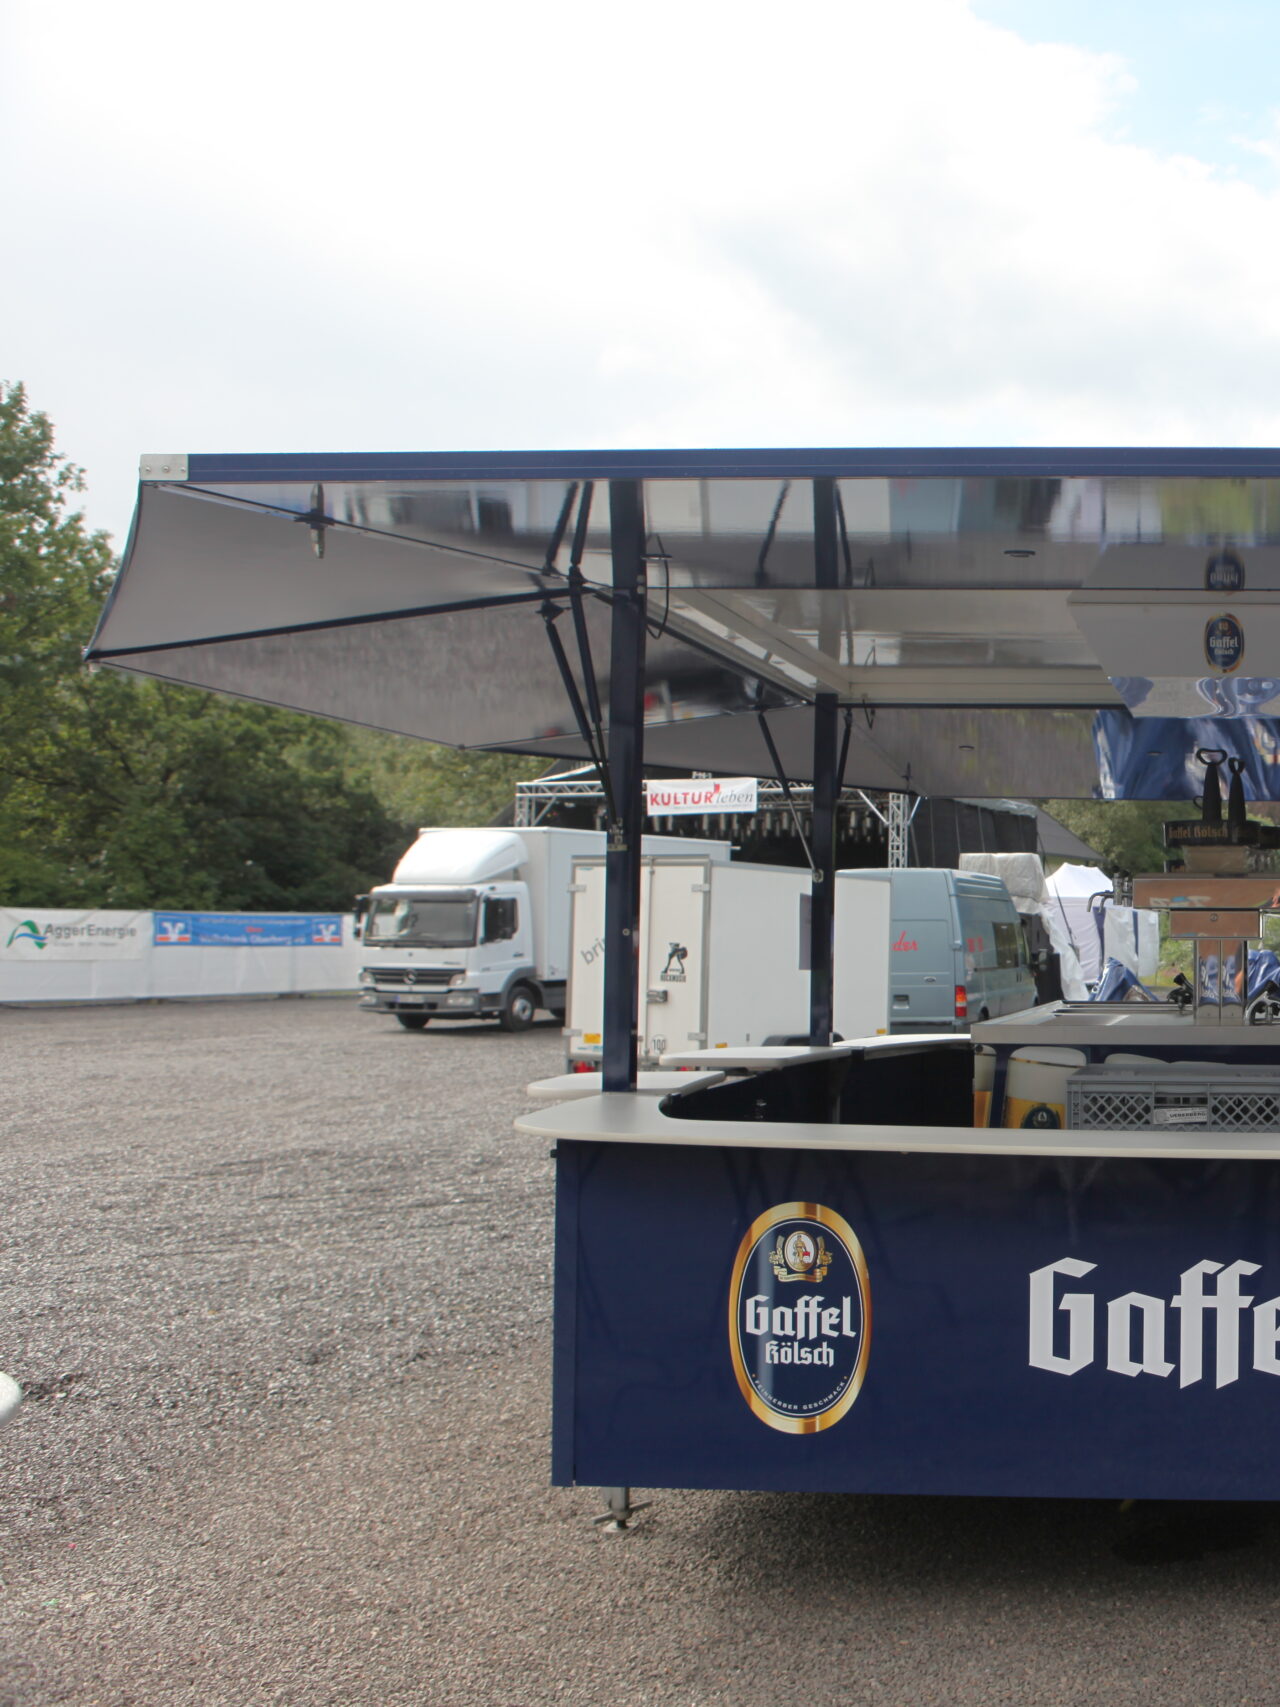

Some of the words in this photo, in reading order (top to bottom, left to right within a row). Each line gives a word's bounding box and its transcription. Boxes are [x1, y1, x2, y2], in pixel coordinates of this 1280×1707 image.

[1209, 636, 1239, 648] Gaffel
[45, 923, 137, 939] AggerEnergie
[652, 1038, 667, 1050] 100
[745, 1294, 857, 1340] Gaffel
[765, 1340, 834, 1368] Kölsch
[802, 1381, 846, 1410] GESCHMACK
